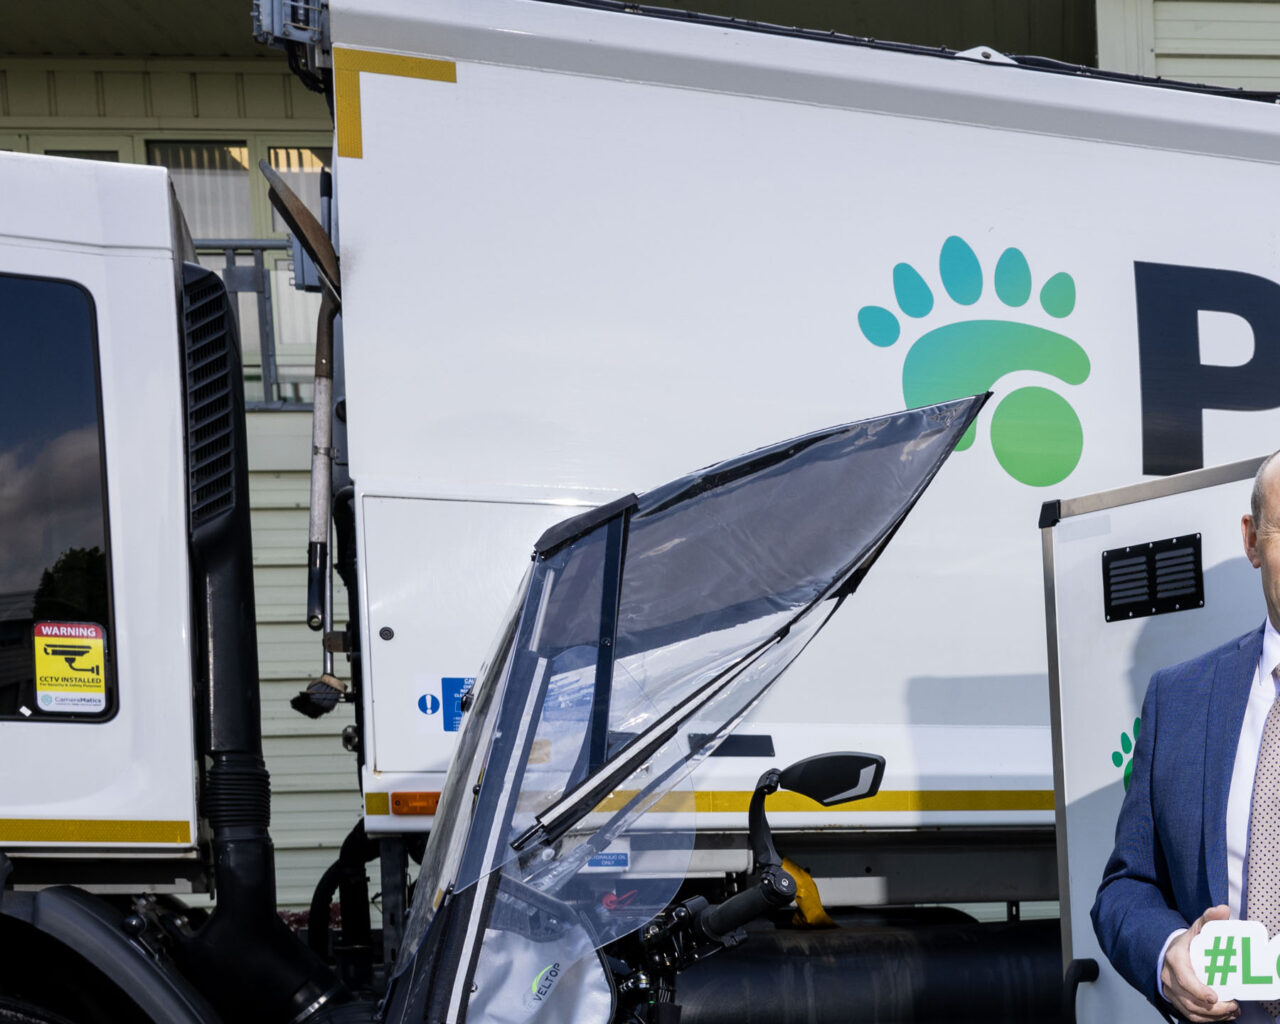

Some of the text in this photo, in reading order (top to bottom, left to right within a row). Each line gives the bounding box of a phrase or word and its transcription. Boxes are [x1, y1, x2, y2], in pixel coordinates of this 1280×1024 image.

[41, 626, 96, 637] WARNING
[61, 676, 102, 684] INSTALLED
[533, 962, 561, 1001] VELTOP
